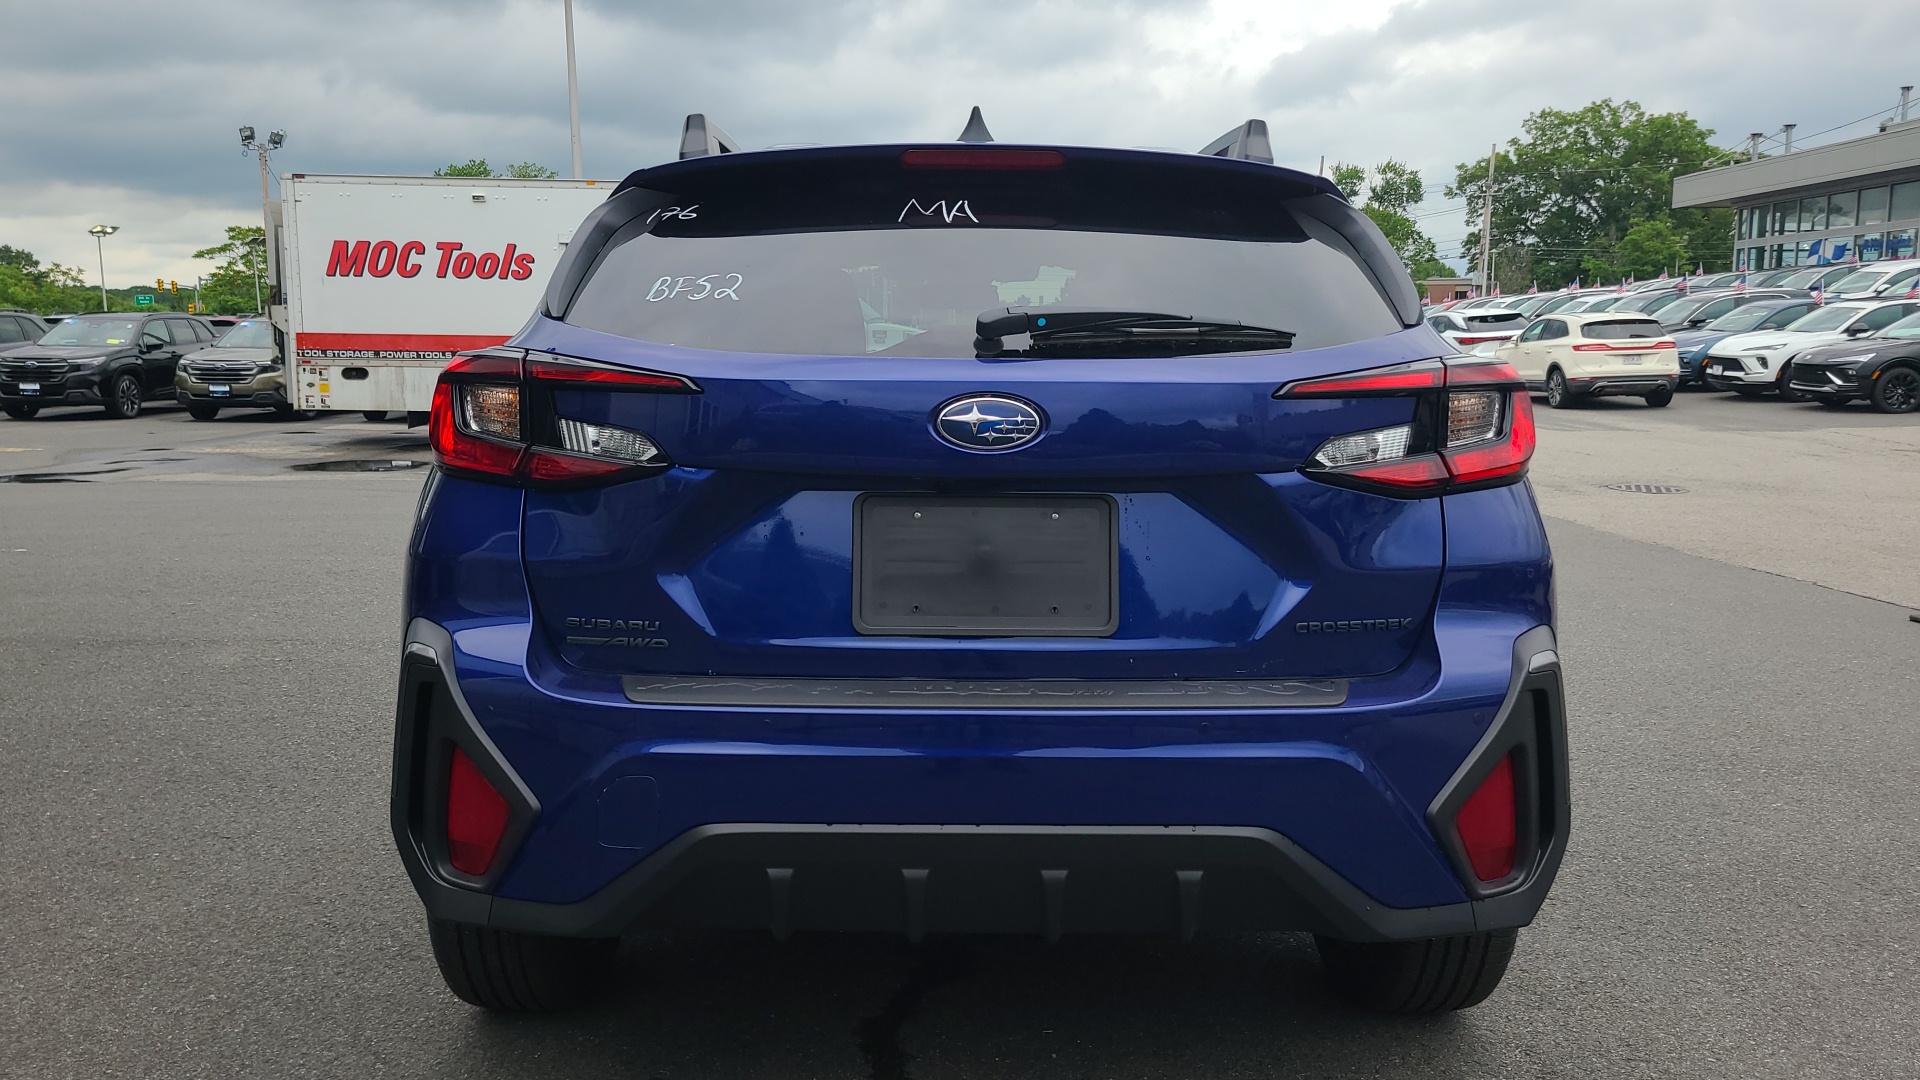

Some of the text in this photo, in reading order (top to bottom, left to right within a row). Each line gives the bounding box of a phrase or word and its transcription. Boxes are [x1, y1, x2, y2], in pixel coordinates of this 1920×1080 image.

[646, 204, 700, 225] 176
[898, 198, 980, 224] MA
[325, 240, 535, 280] MOC Tools
[645, 273, 743, 302] BF52
[298, 350, 325, 358] TOOL
[418, 351, 453, 360] TOOLS
[565, 616, 661, 632] SUBARU
[1295, 617, 1413, 634] CROSSTREK
[603, 637, 670, 648] AWD
